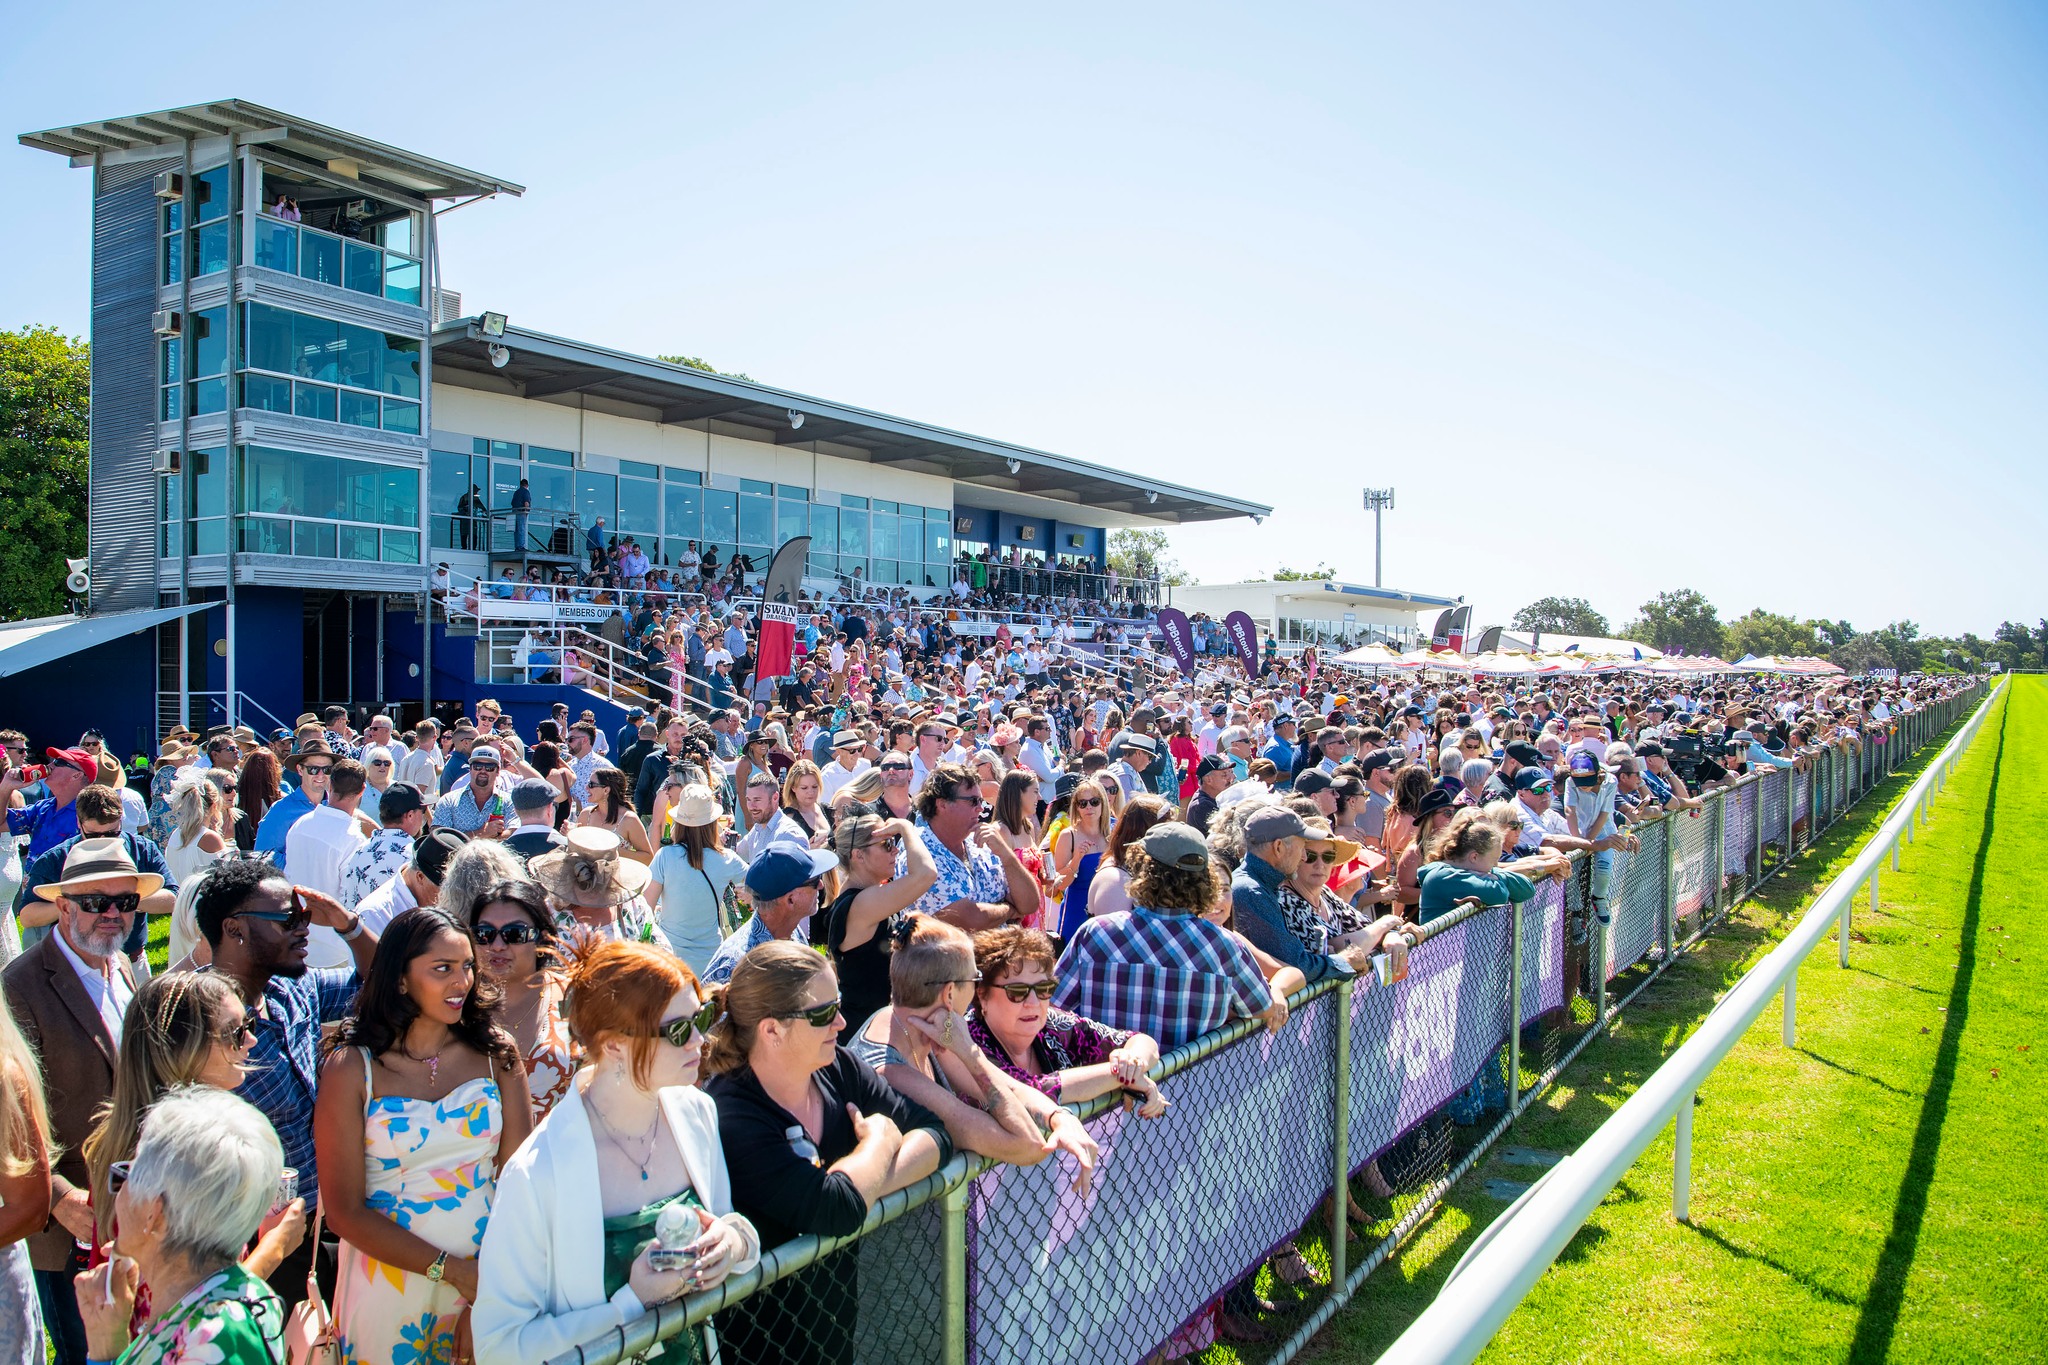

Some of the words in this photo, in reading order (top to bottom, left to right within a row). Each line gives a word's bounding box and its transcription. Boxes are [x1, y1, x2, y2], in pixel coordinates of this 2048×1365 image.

[559, 608, 595, 617] MEMBERS
[764, 604, 797, 617] SWAN
[766, 613, 794, 623] DRAUGHT
[1165, 619, 1189, 661] TABtouch
[1232, 620, 1253, 659] TABtouch
[1874, 668, 1897, 677] 2000
